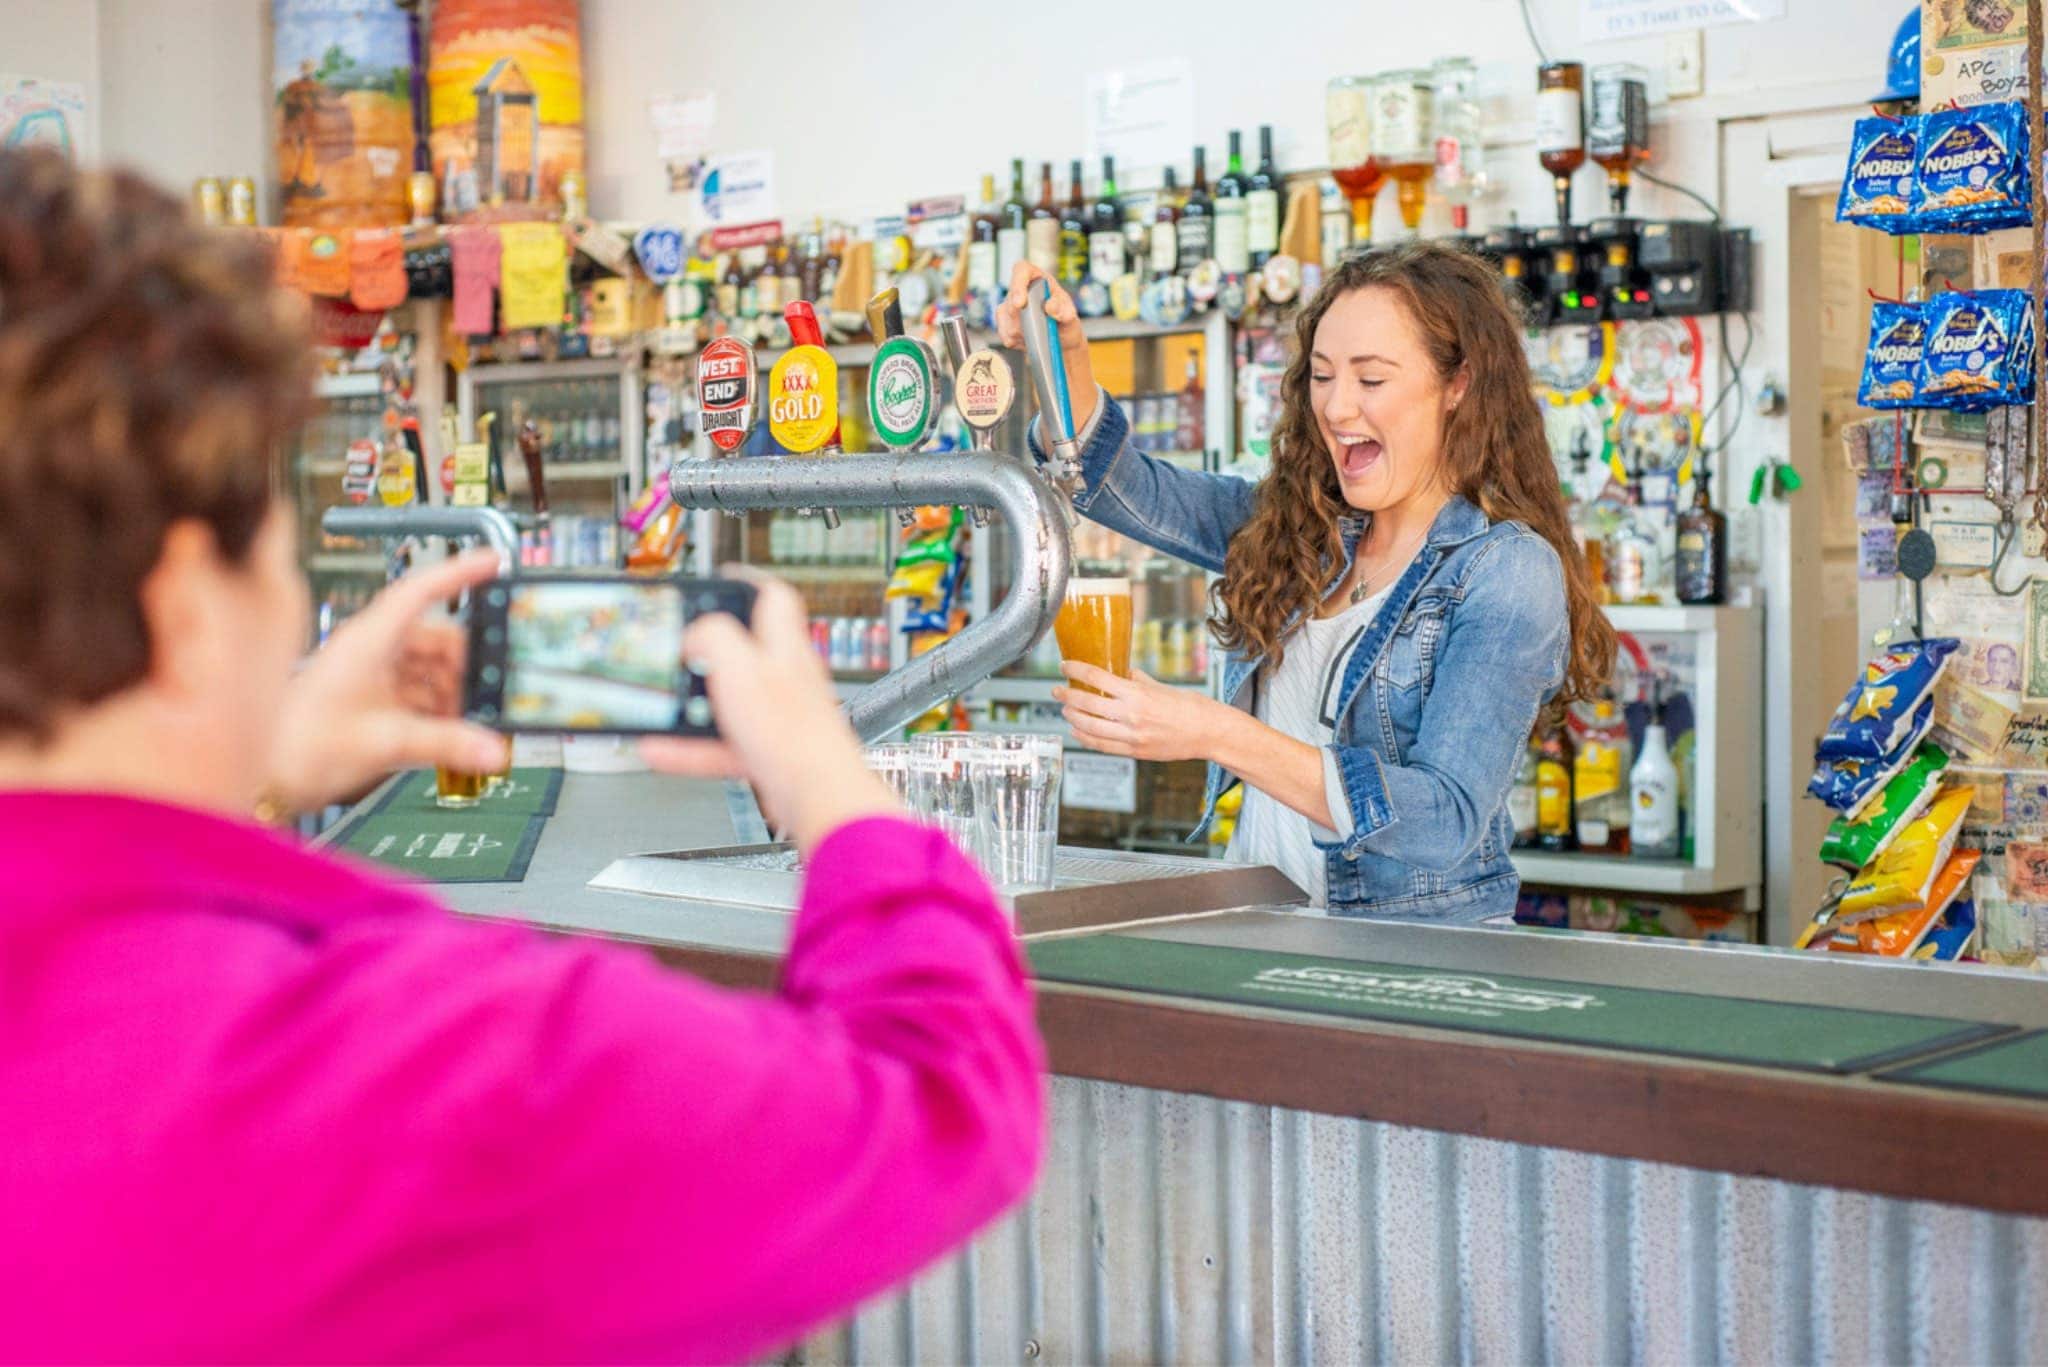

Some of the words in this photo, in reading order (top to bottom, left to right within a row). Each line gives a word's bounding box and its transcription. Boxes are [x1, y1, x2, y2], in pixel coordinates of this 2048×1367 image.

[1684, 4, 1710, 18] TO
[1957, 60, 1996, 79] APC
[1925, 146, 2001, 174] NOBBY'S
[700, 358, 741, 379] WEST
[705, 383, 736, 401] END
[782, 375, 813, 392] XXXX
[966, 384, 998, 398] GREAT
[771, 394, 823, 423] GOLD
[702, 408, 743, 432] DRAUGHT
